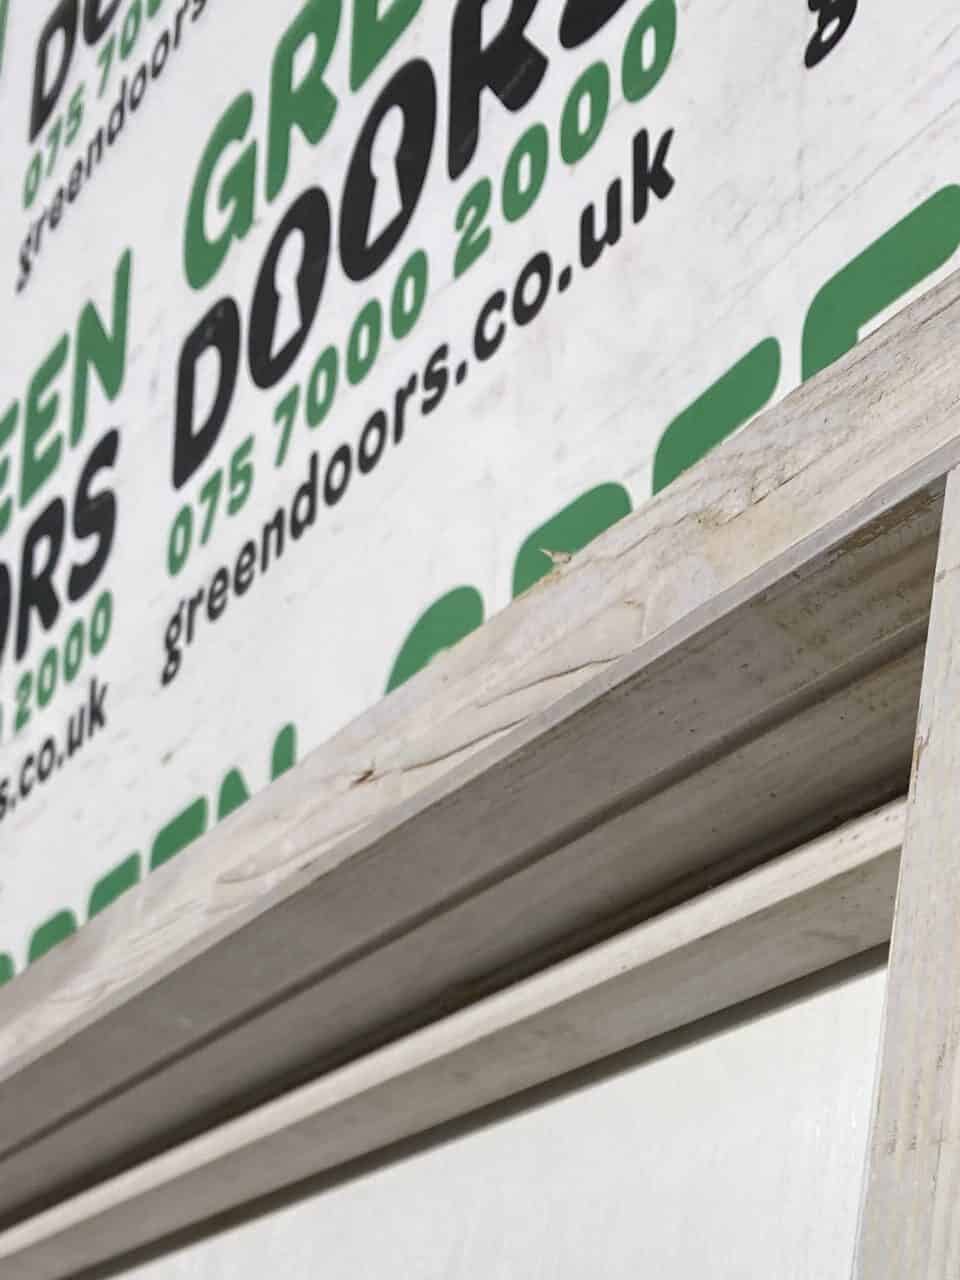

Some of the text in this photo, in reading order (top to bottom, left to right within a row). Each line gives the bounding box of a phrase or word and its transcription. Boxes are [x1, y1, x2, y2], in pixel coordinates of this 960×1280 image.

[160, 127, 675, 688] greendoors.co.uk
[165, 0, 677, 577] 075 7000 2000
[14, 587, 113, 734] 2000
